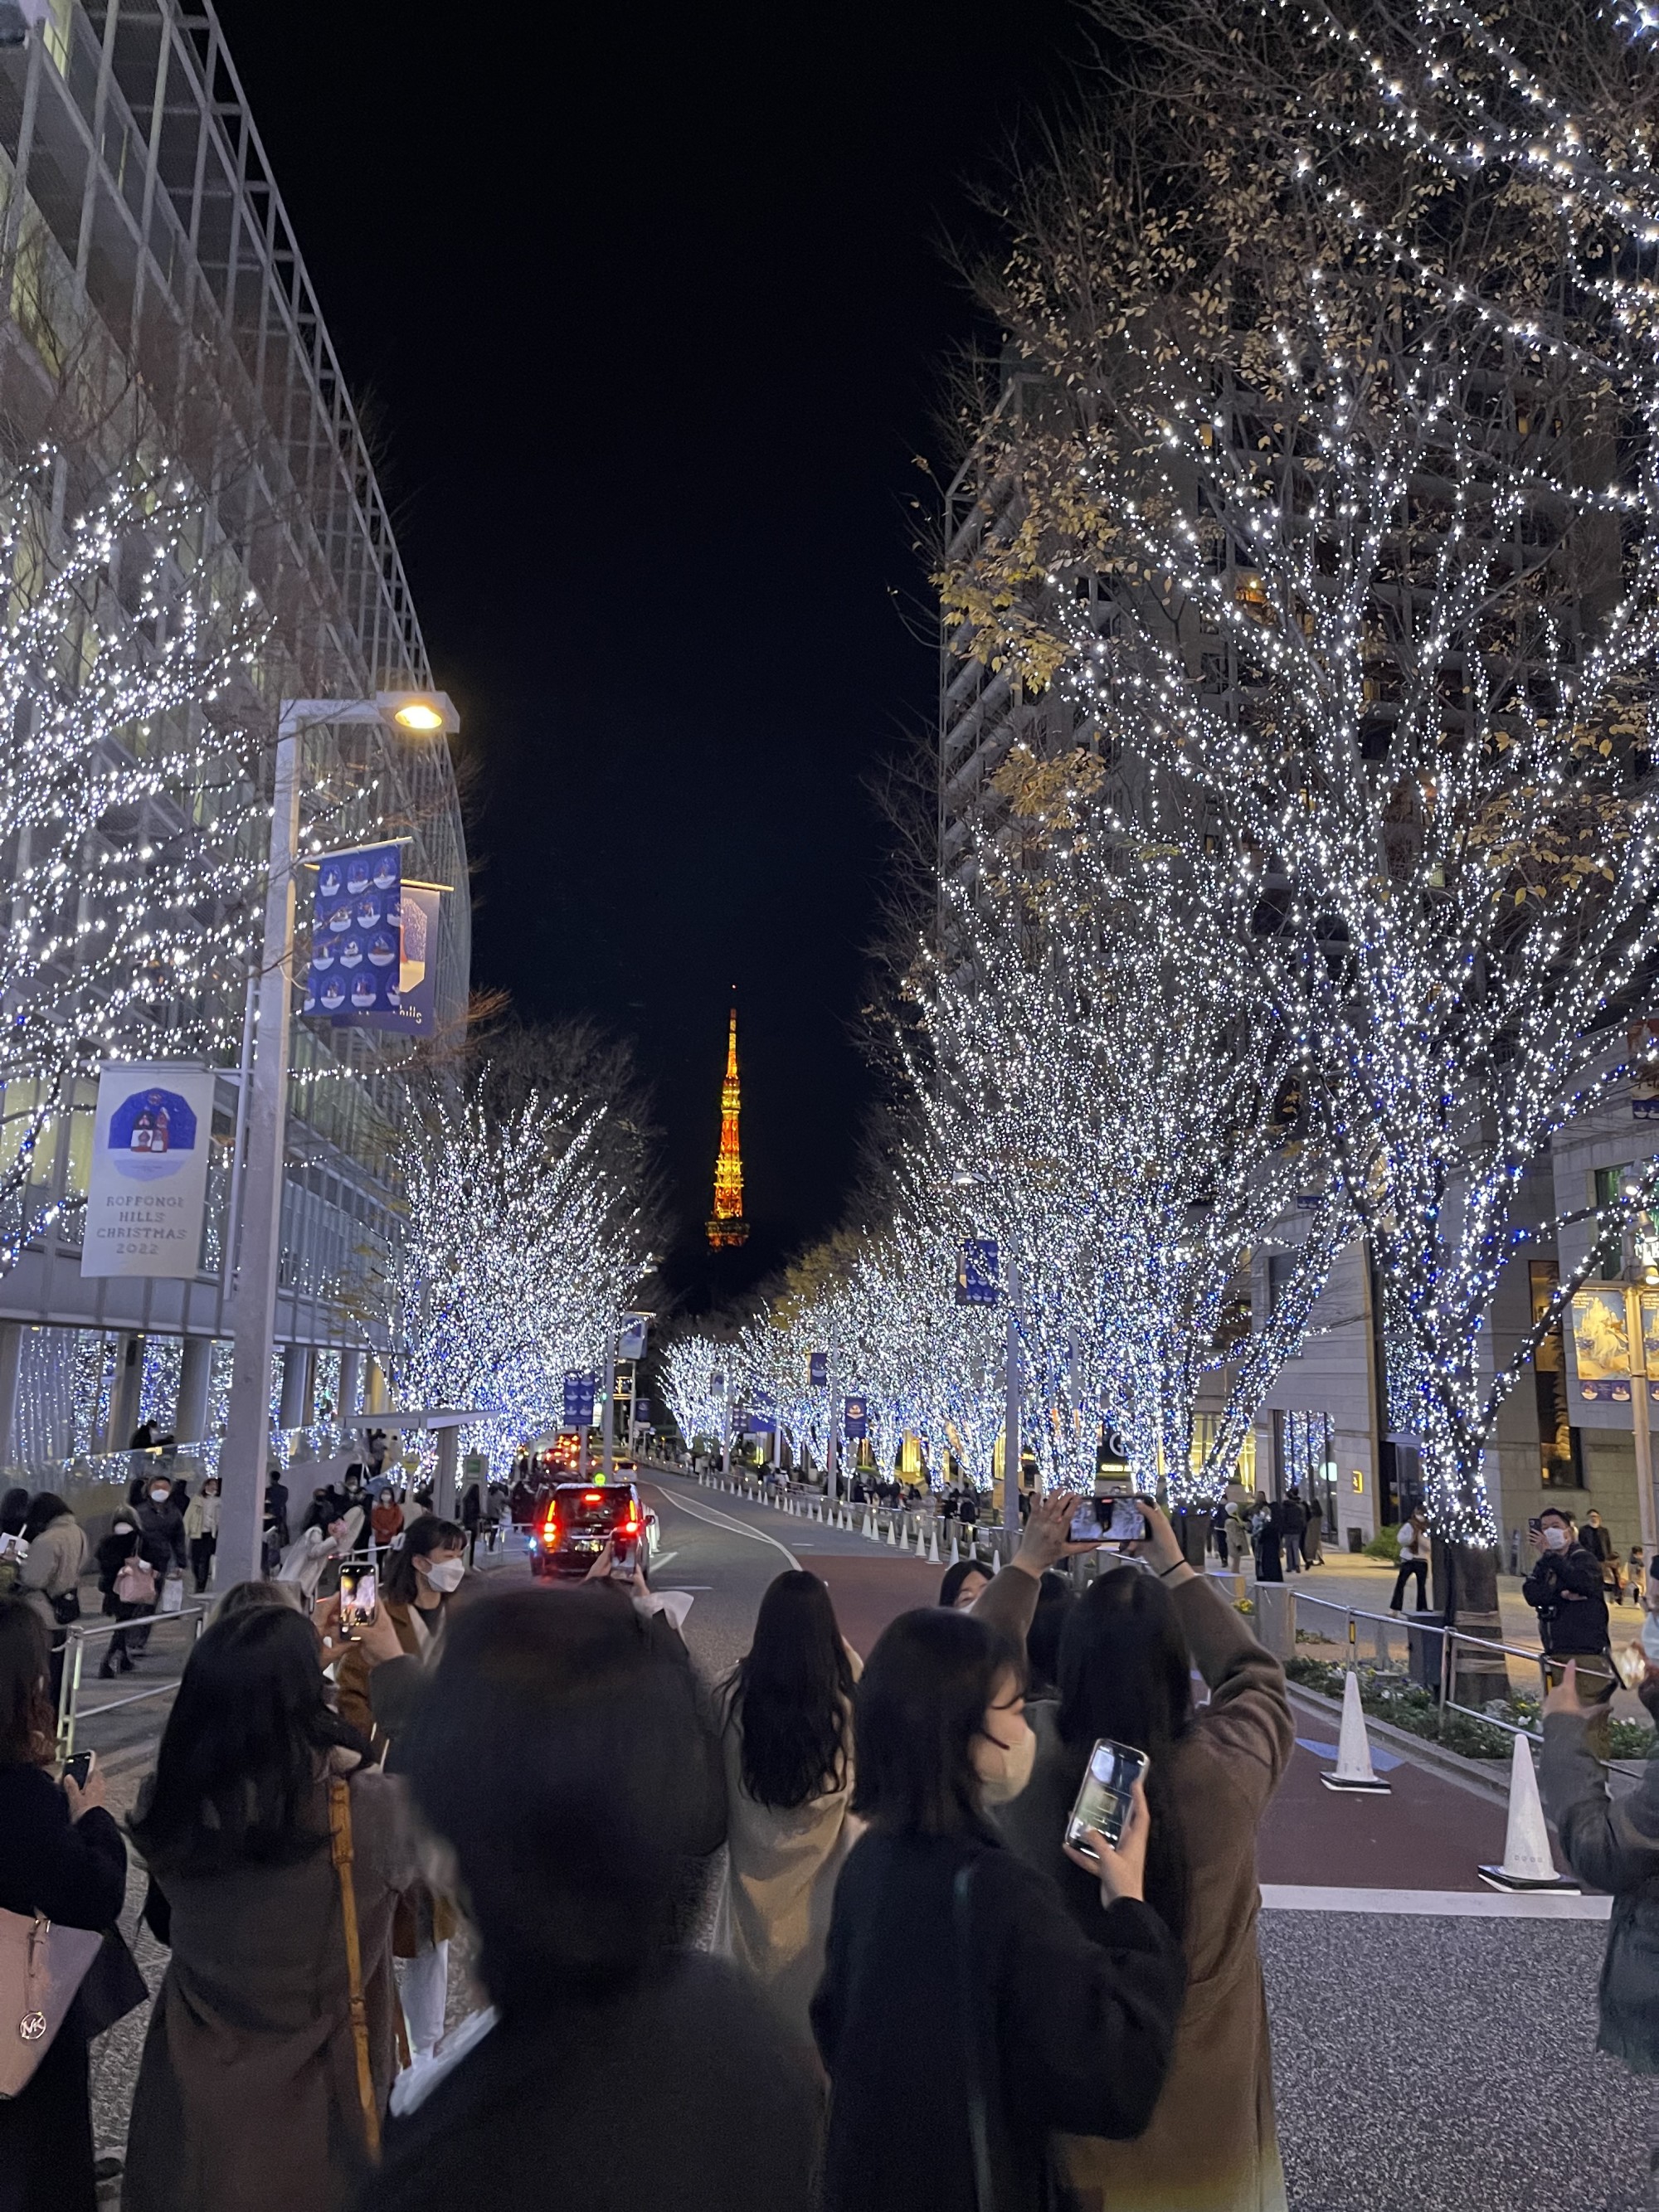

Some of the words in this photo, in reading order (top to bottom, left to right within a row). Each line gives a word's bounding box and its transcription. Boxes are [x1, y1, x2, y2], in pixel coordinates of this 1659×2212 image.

[119, 1211, 166, 1223] HILLS
[96, 1228, 188, 1240] CHRISTMAS
[116, 1242, 160, 1255] 2022
